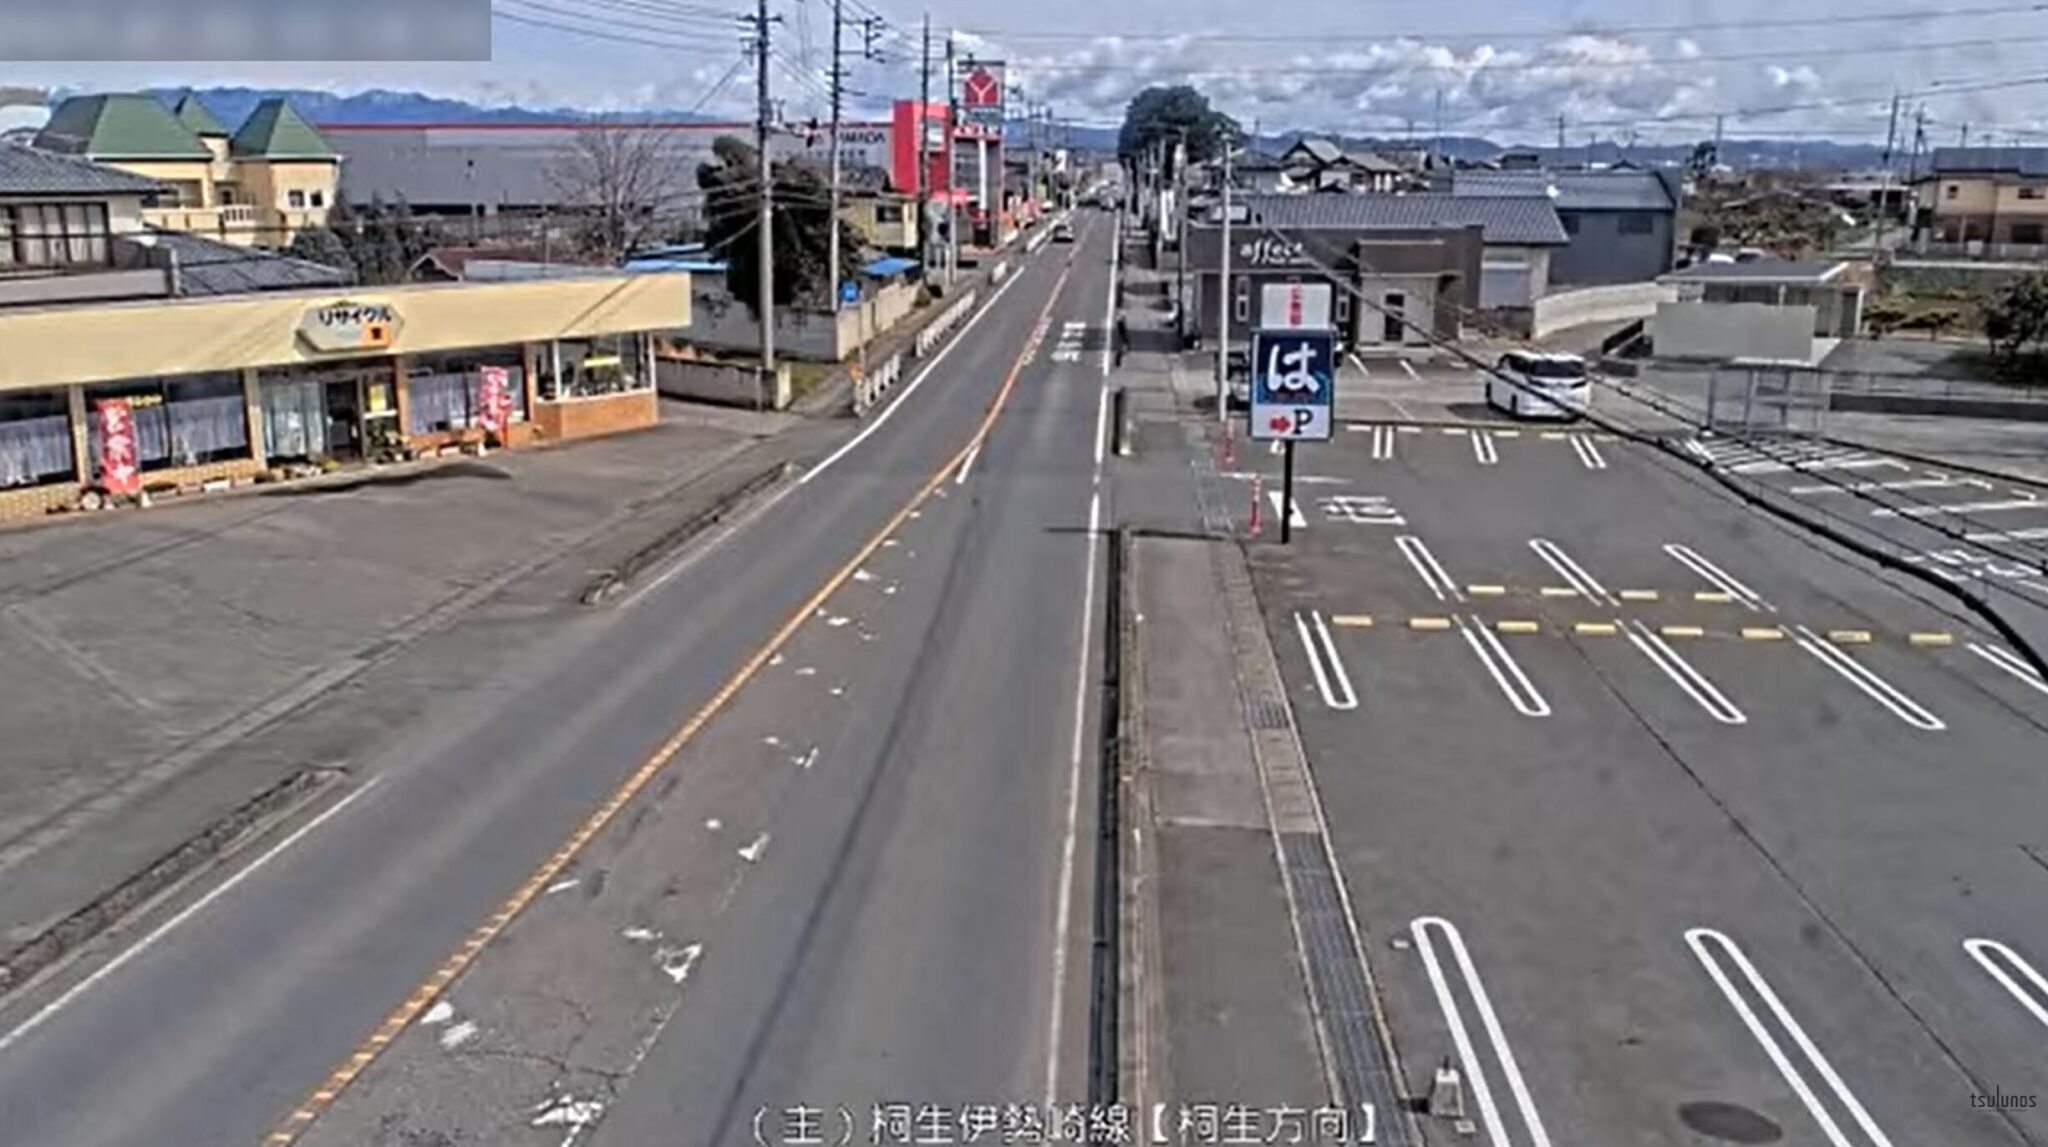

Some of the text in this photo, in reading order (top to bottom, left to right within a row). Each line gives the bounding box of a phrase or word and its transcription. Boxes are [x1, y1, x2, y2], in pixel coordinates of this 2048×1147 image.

[318, 305, 392, 327] リサイクル
[1266, 342, 1320, 392] は
[1293, 407, 1314, 435] P
